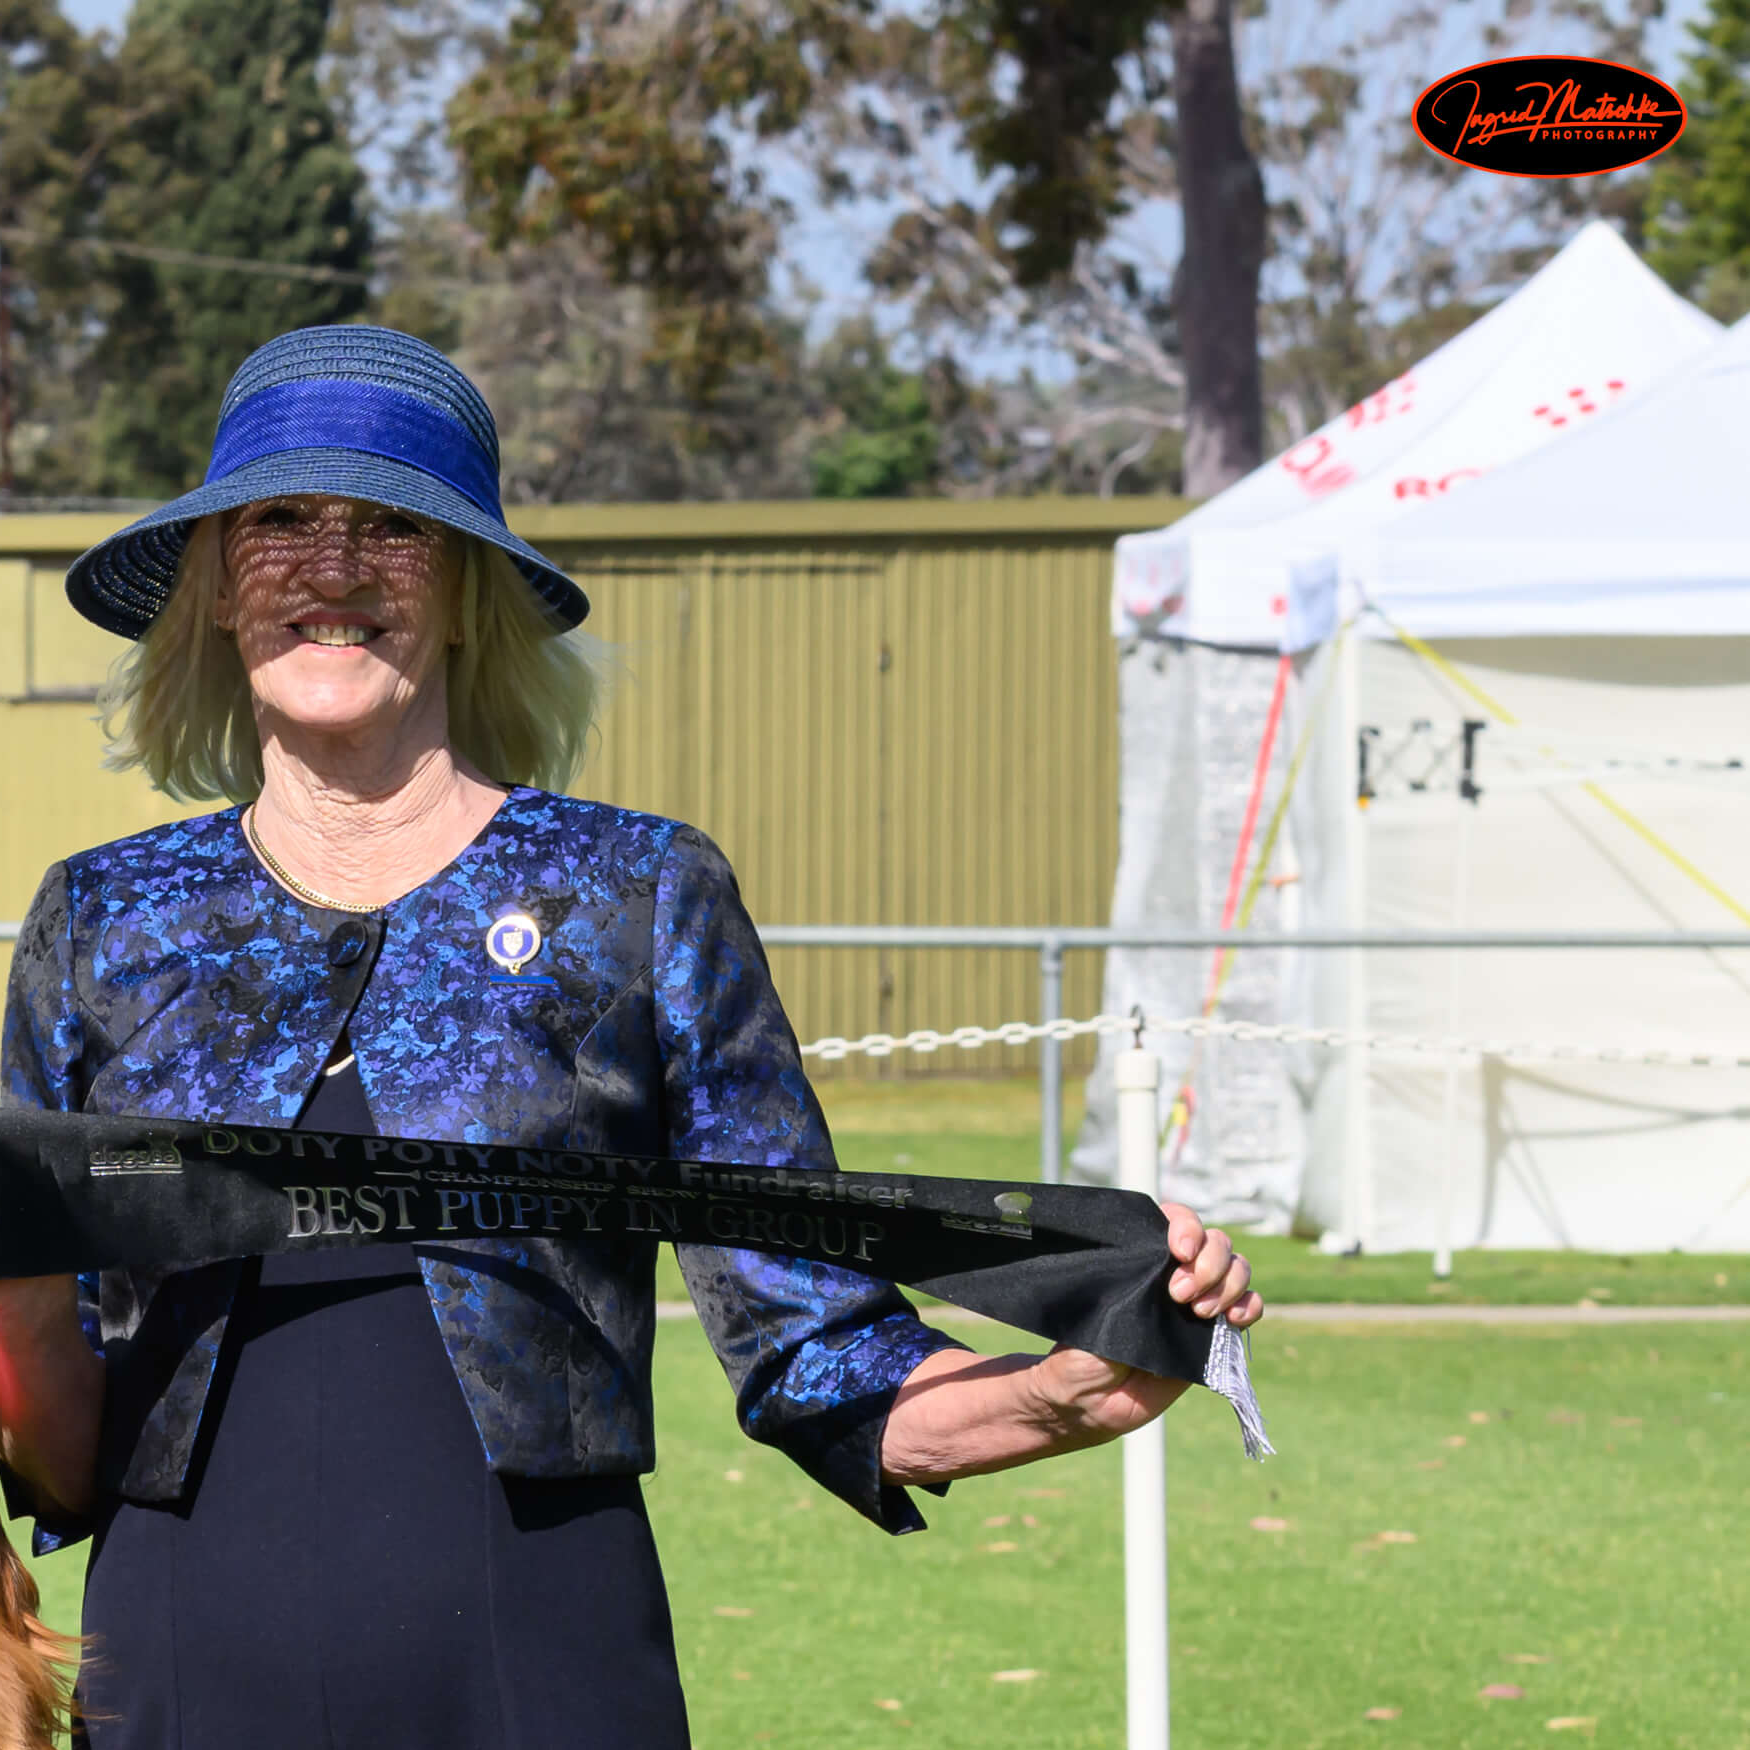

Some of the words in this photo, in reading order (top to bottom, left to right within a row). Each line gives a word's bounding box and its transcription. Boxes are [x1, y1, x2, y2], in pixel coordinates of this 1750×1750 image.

[202, 1129, 343, 1159] DOTY
[362, 1138, 494, 1169] POTY
[516, 1151, 656, 1180] NOTY
[679, 1162, 913, 1208] Fundraiser
[425, 1170, 615, 1192] CHAMPIONSHIP
[282, 1185, 420, 1238] BEST
[434, 1189, 609, 1231] PUPPY
[624, 1199, 682, 1234] IN
[707, 1205, 884, 1261] GROUP
